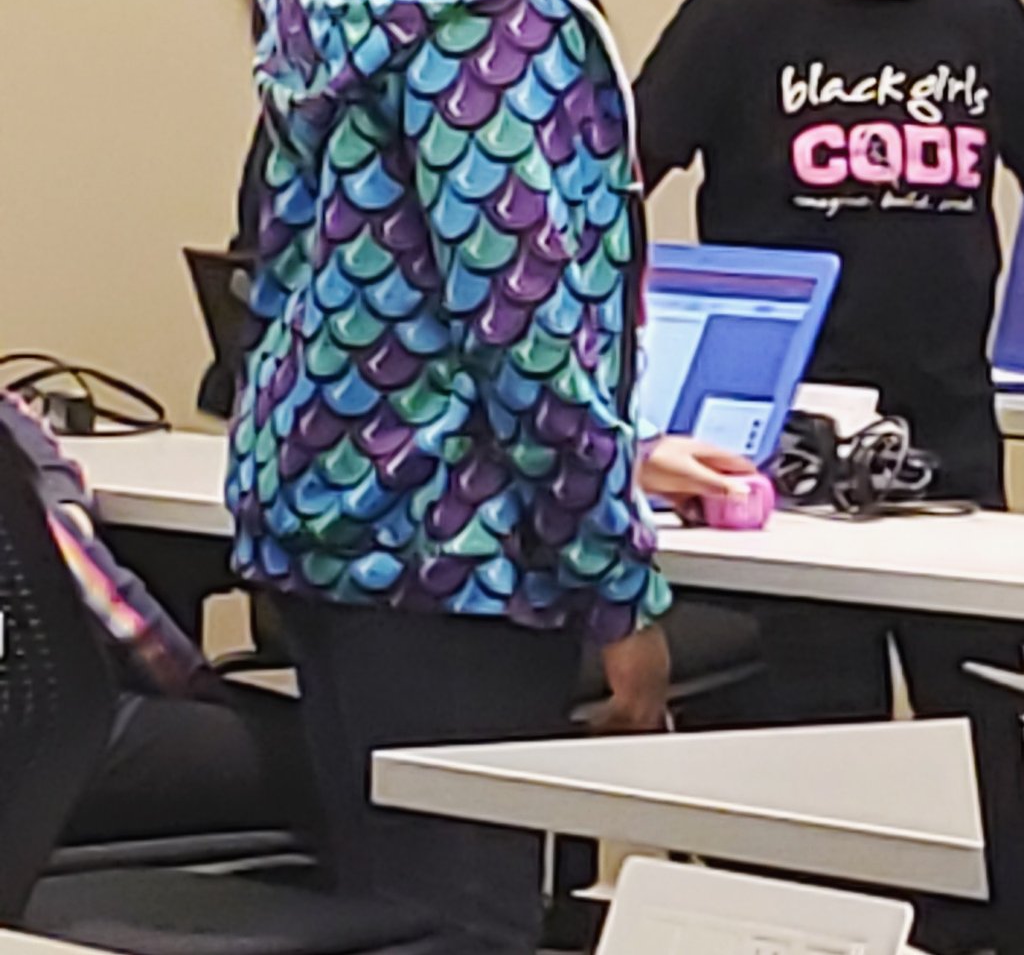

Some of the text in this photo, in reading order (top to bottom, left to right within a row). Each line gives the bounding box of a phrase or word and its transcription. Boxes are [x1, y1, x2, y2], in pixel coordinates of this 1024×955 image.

[781, 61, 989, 124] black girls
[792, 119, 987, 190] CODE
